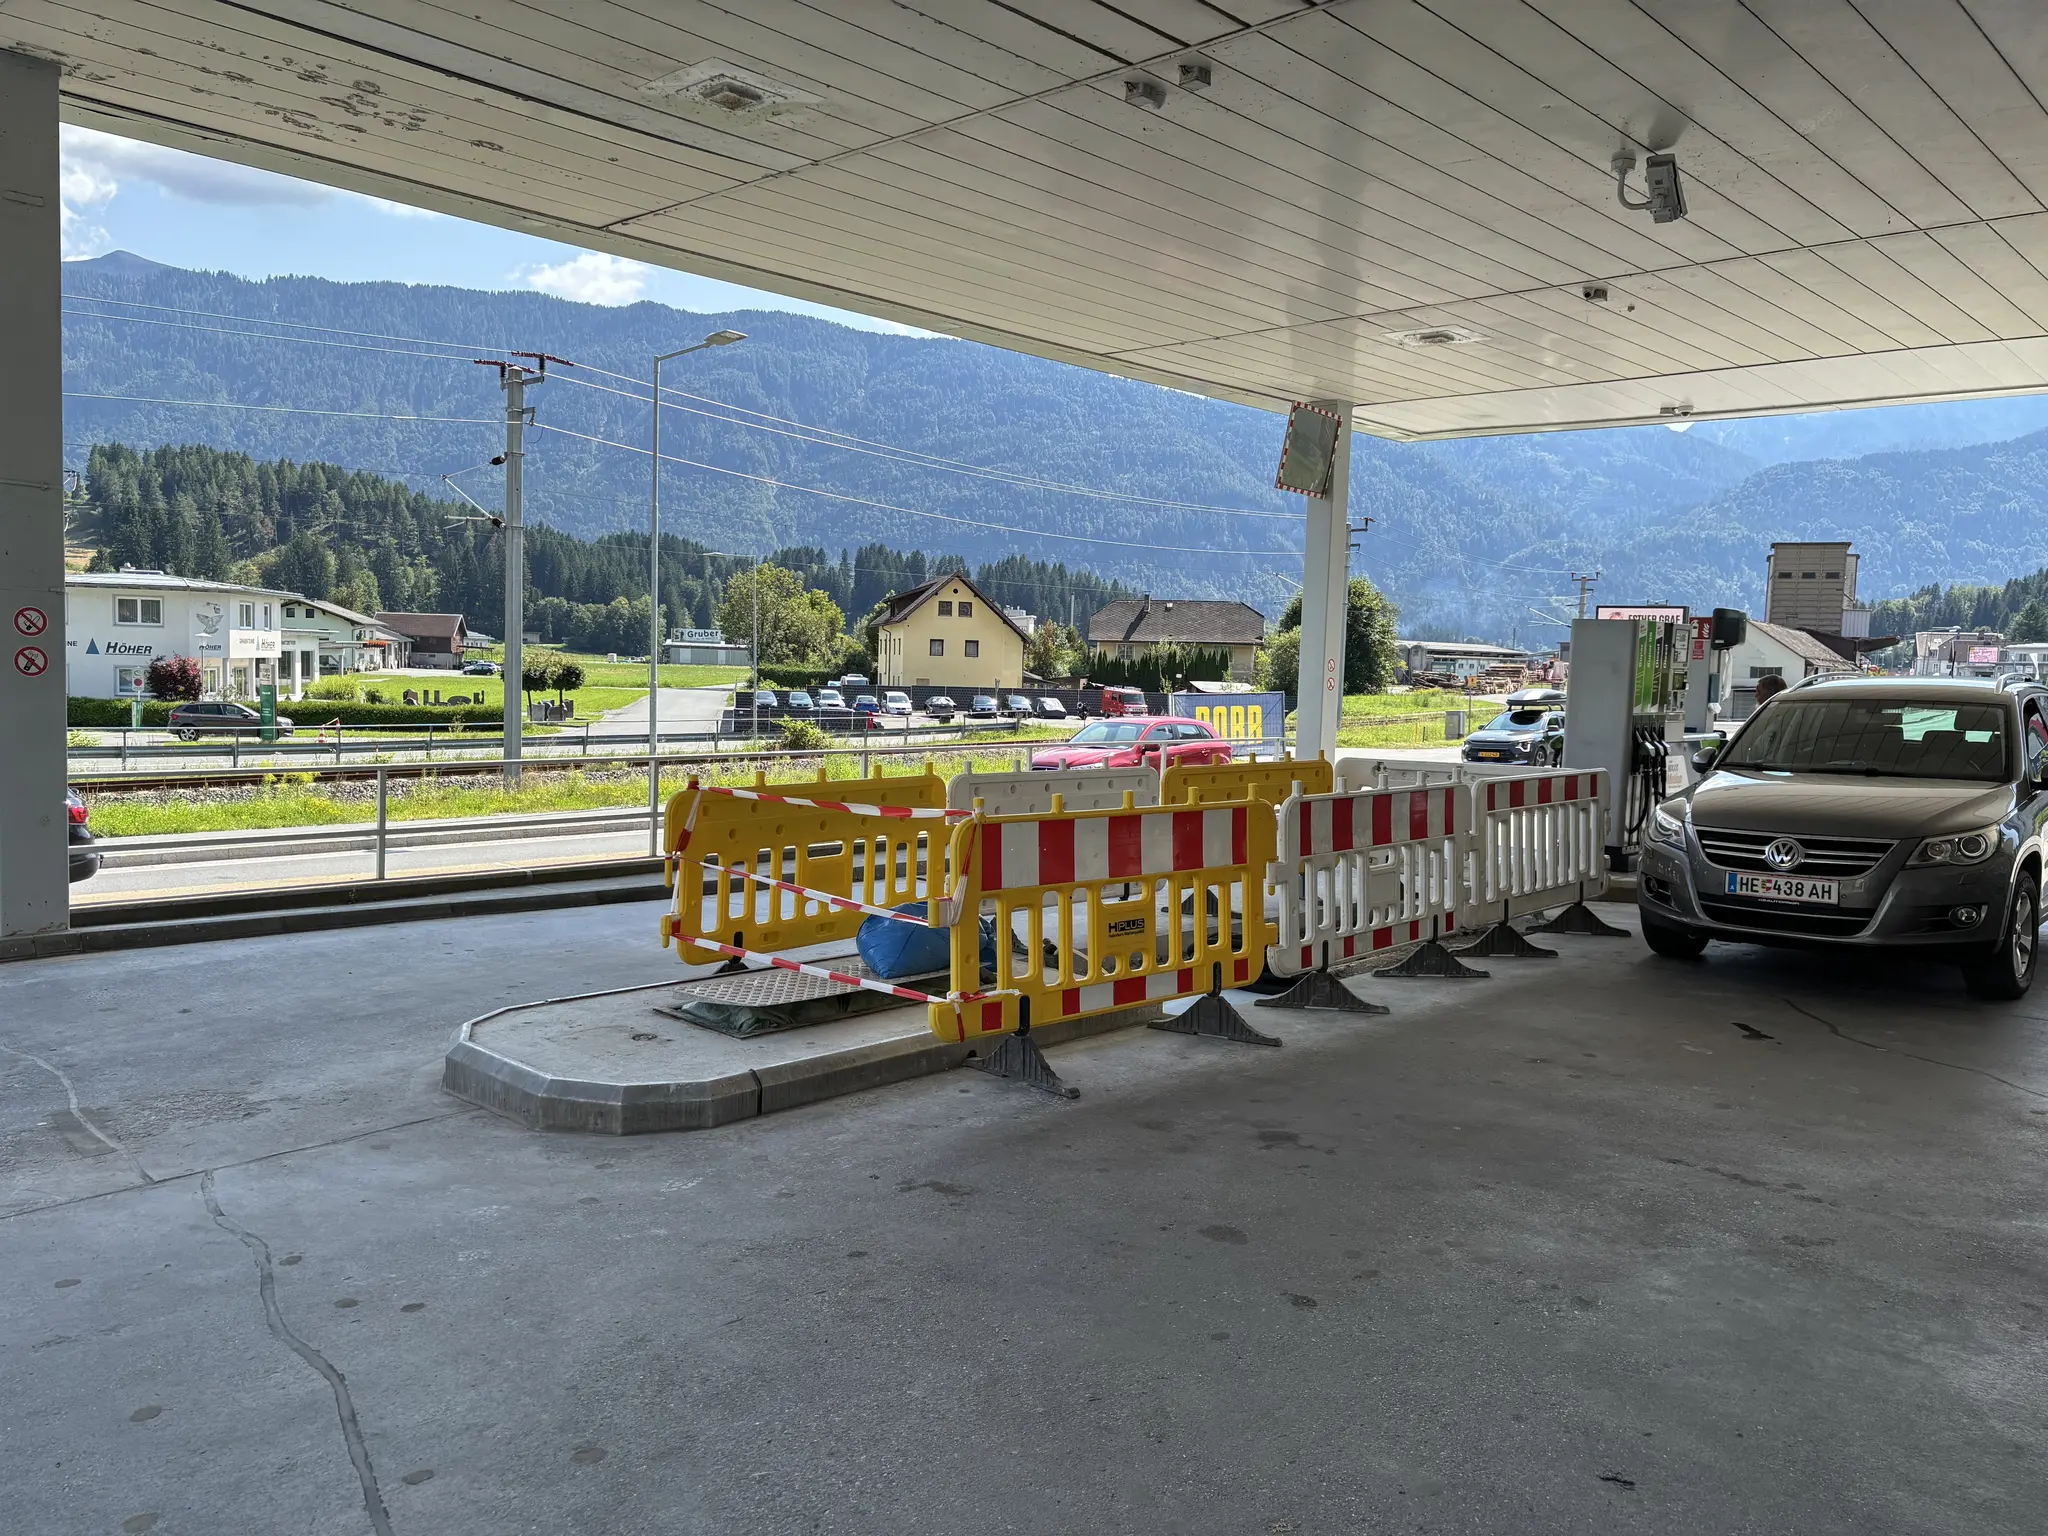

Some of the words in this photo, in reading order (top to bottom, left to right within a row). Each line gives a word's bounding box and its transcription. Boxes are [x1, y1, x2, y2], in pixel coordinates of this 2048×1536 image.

[105, 641, 153, 655] HÖHER
[1739, 876, 1760, 893] HE
[1772, 880, 1805, 897] 438
[1808, 883, 1832, 900] AH
